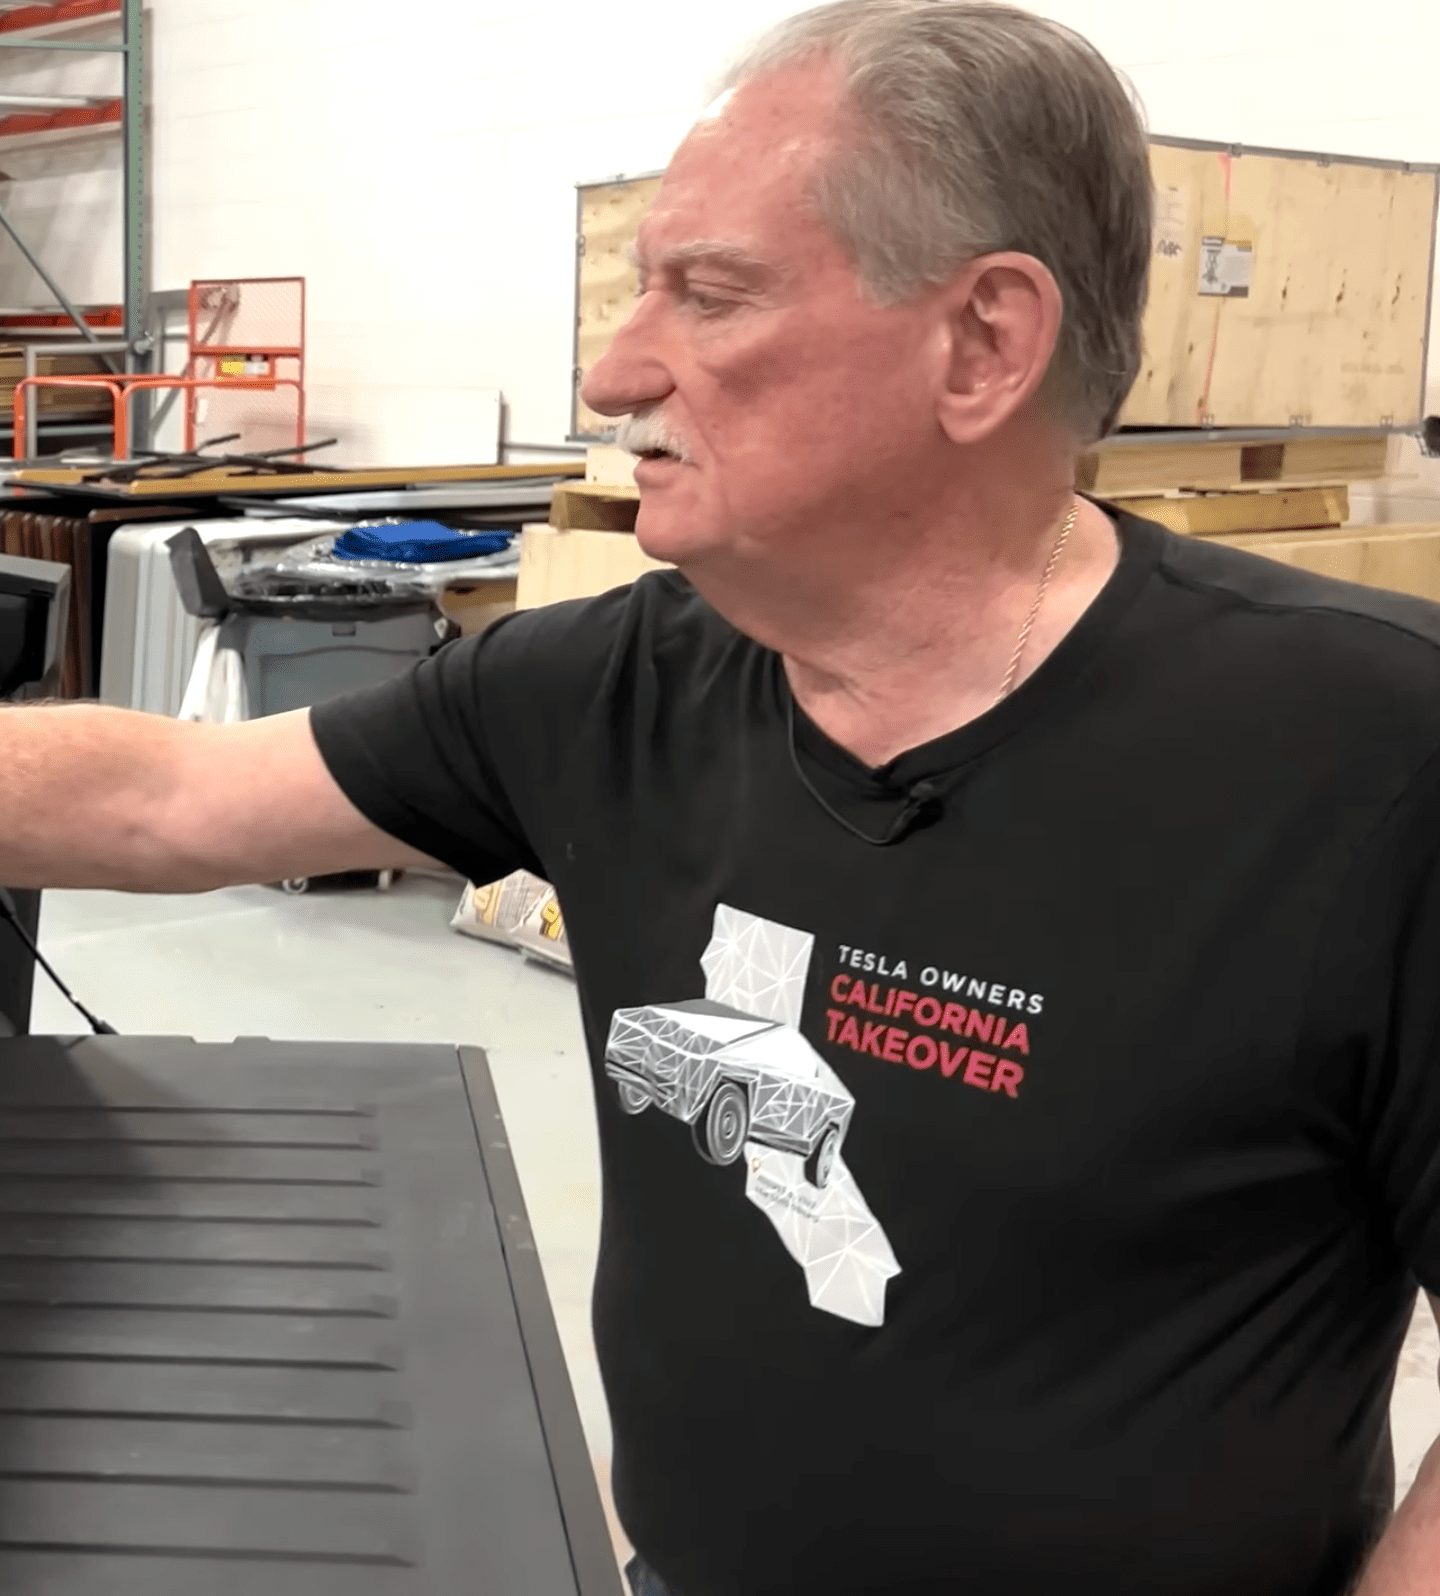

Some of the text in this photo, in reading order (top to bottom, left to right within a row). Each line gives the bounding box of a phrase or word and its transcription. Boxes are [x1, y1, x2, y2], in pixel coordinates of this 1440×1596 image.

[830, 973, 1030, 1055] CALIFORNIA
[838, 944, 1045, 1015] TESLA OWNERS
[826, 1008, 1024, 1098] TAKEOVER
